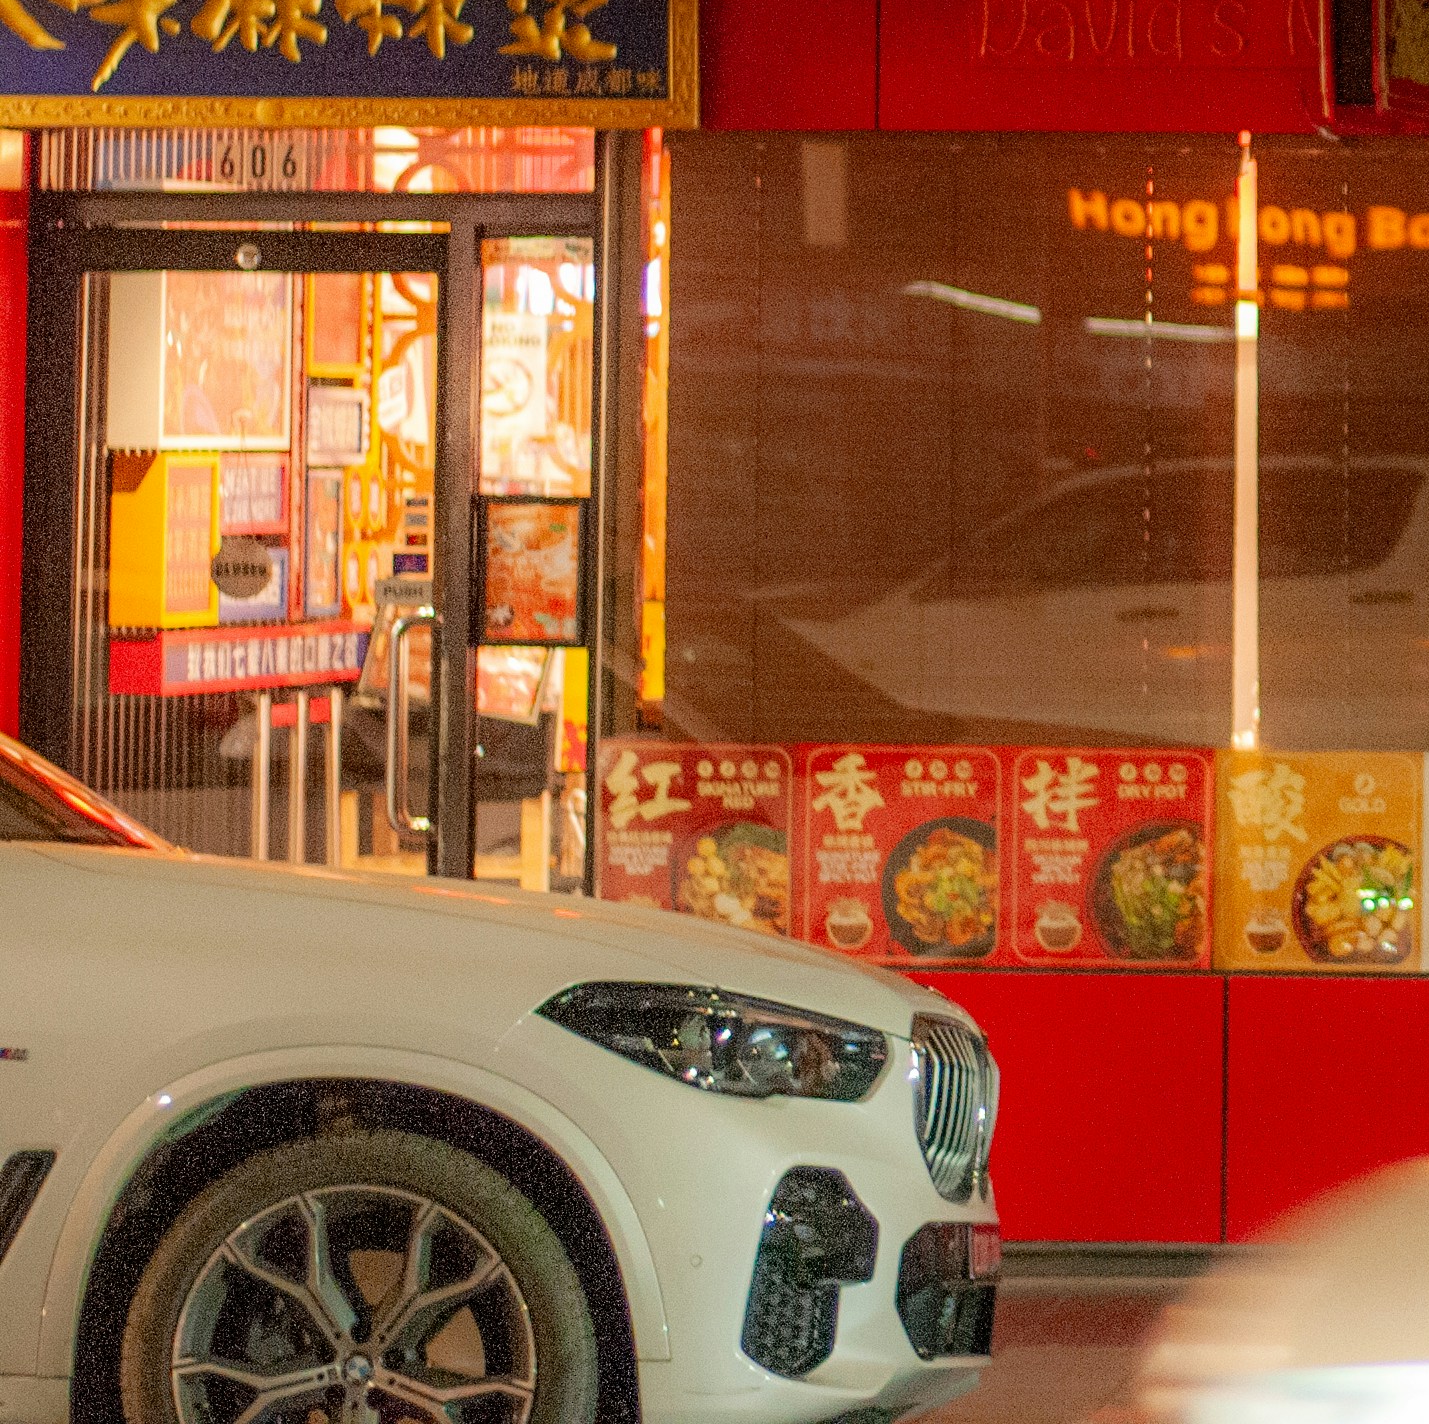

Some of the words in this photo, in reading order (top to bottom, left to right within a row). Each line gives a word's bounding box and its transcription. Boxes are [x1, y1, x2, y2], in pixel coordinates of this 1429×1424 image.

[218, 141, 298, 179] 606
[1067, 186, 1220, 253] Hong
[812, 752, 886, 831] 香
[1338, 796, 1388, 814] GOLD
